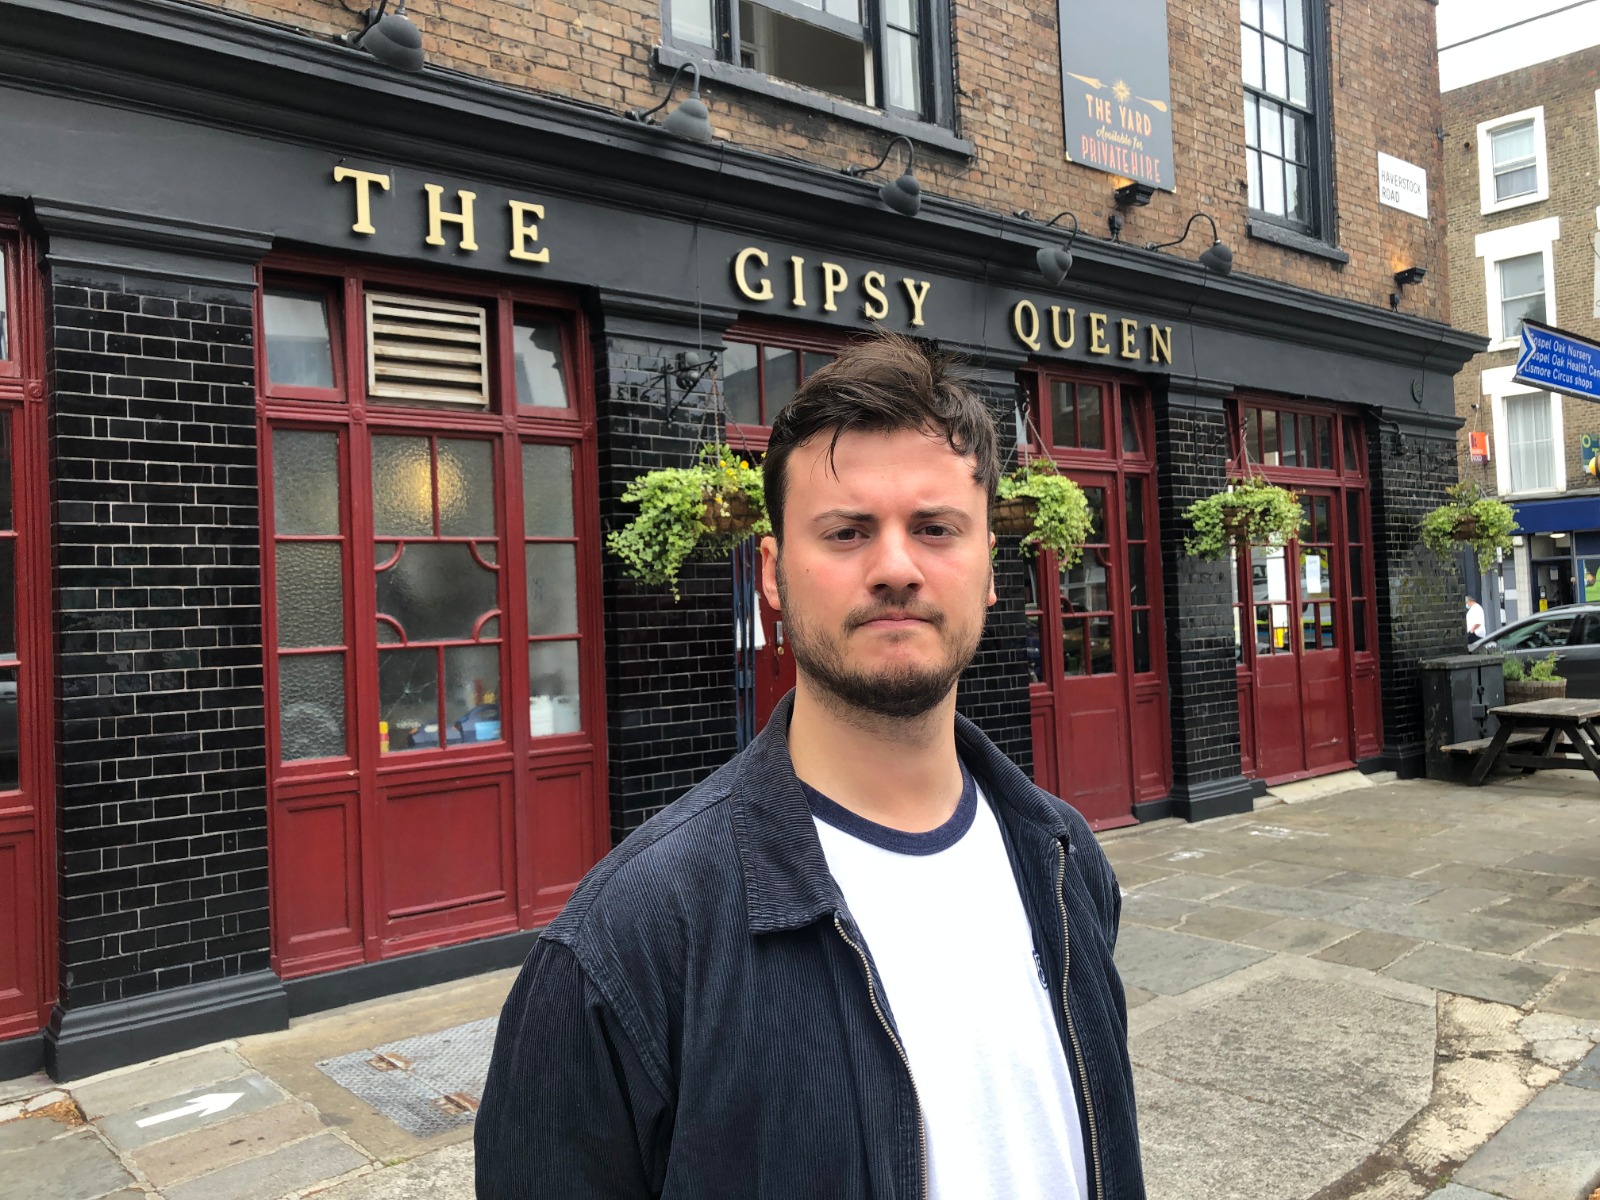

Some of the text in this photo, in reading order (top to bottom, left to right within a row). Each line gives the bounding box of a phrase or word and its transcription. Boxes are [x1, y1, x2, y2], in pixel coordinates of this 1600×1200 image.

[1085, 93, 1152, 137] THE YARD
[1096, 125, 1132, 146] Available
[1081, 134, 1161, 183] PRIVATE HIRE
[1381, 170, 1421, 195] HAVERSTOCK
[1382, 186, 1400, 203] ROAD
[333, 165, 1172, 364] THE GIPSY QUEEN
[1530, 333, 1592, 364] ospel Oak Nursery
[1525, 362, 1593, 389] Lismore Circus shops
[1532, 352, 1550, 364] ospel
[1552, 354, 1565, 367] Oak
[1567, 359, 1588, 374] Health
